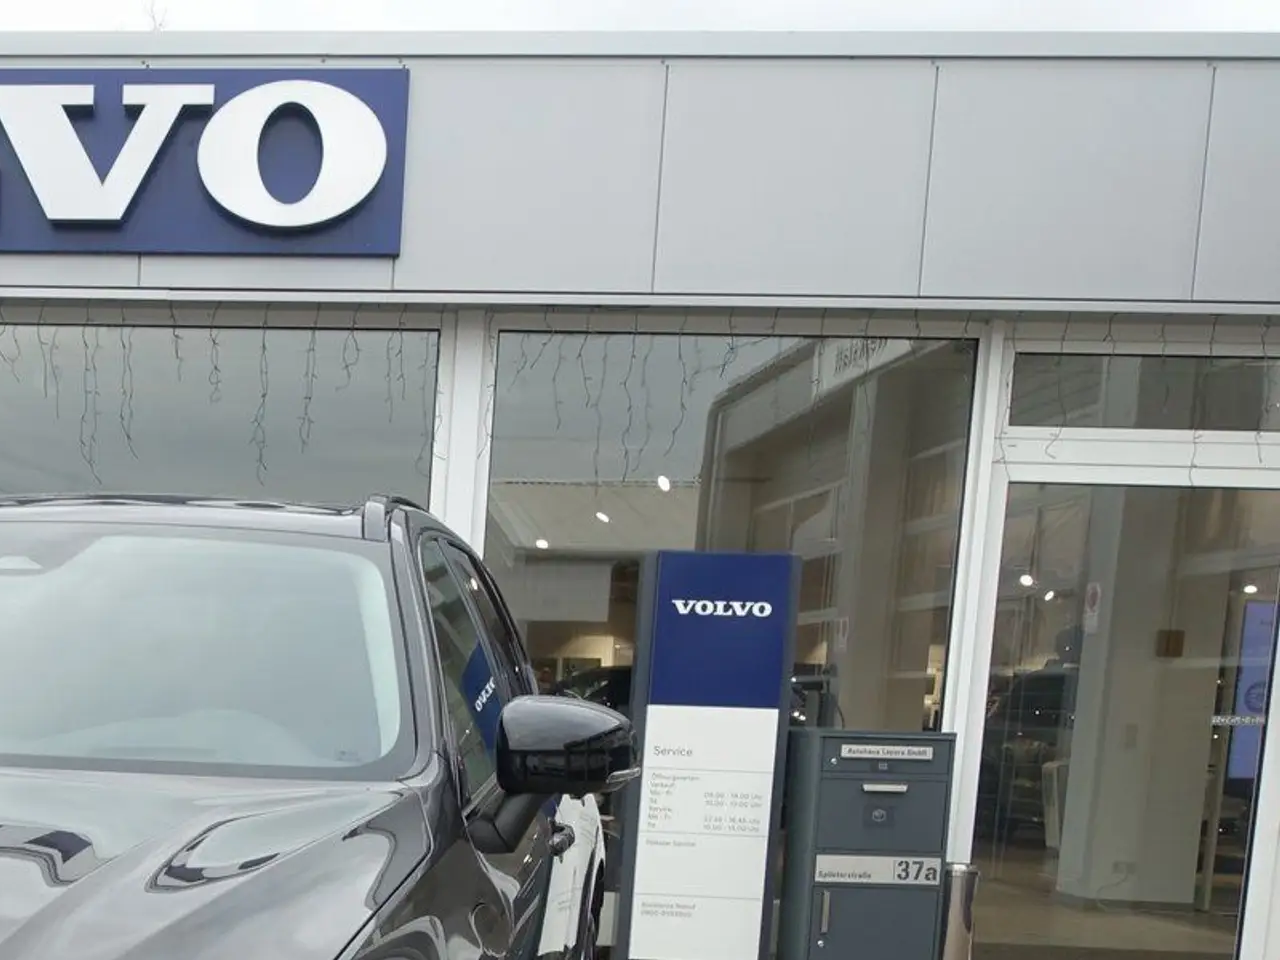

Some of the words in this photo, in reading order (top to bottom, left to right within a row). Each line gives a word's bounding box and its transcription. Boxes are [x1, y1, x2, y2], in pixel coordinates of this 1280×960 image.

[672, 599, 772, 617] VOLVO
[653, 745, 693, 757] Service
[897, 860, 937, 881] 37a
